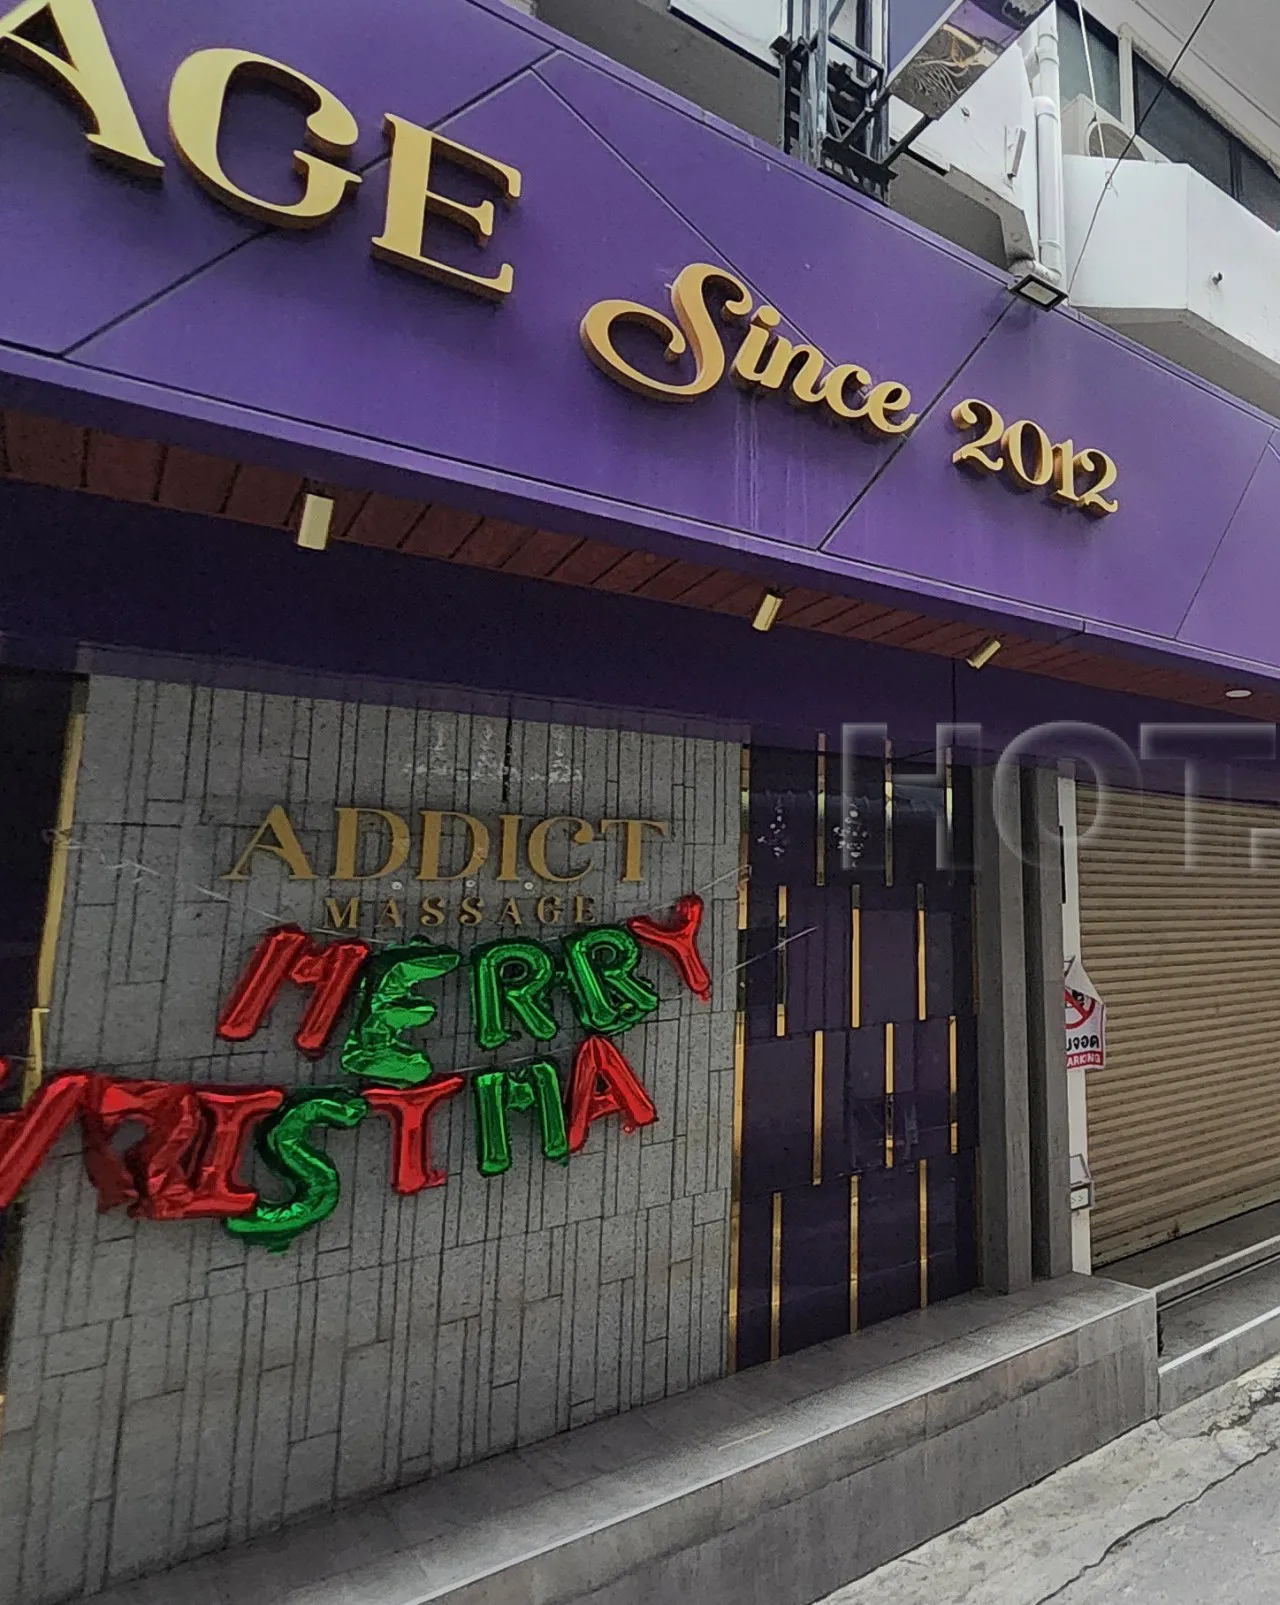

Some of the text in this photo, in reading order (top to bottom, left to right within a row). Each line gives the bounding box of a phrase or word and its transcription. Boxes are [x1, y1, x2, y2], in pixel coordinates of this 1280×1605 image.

[579, 262, 918, 438] Since
[951, 397, 1120, 517] 2012
[221, 804, 669, 884] ADDICT
[324, 896, 599, 930] MASSAGE
[215, 894, 712, 1084] MERRY
[1066, 1053, 1101, 1068] ARKING
